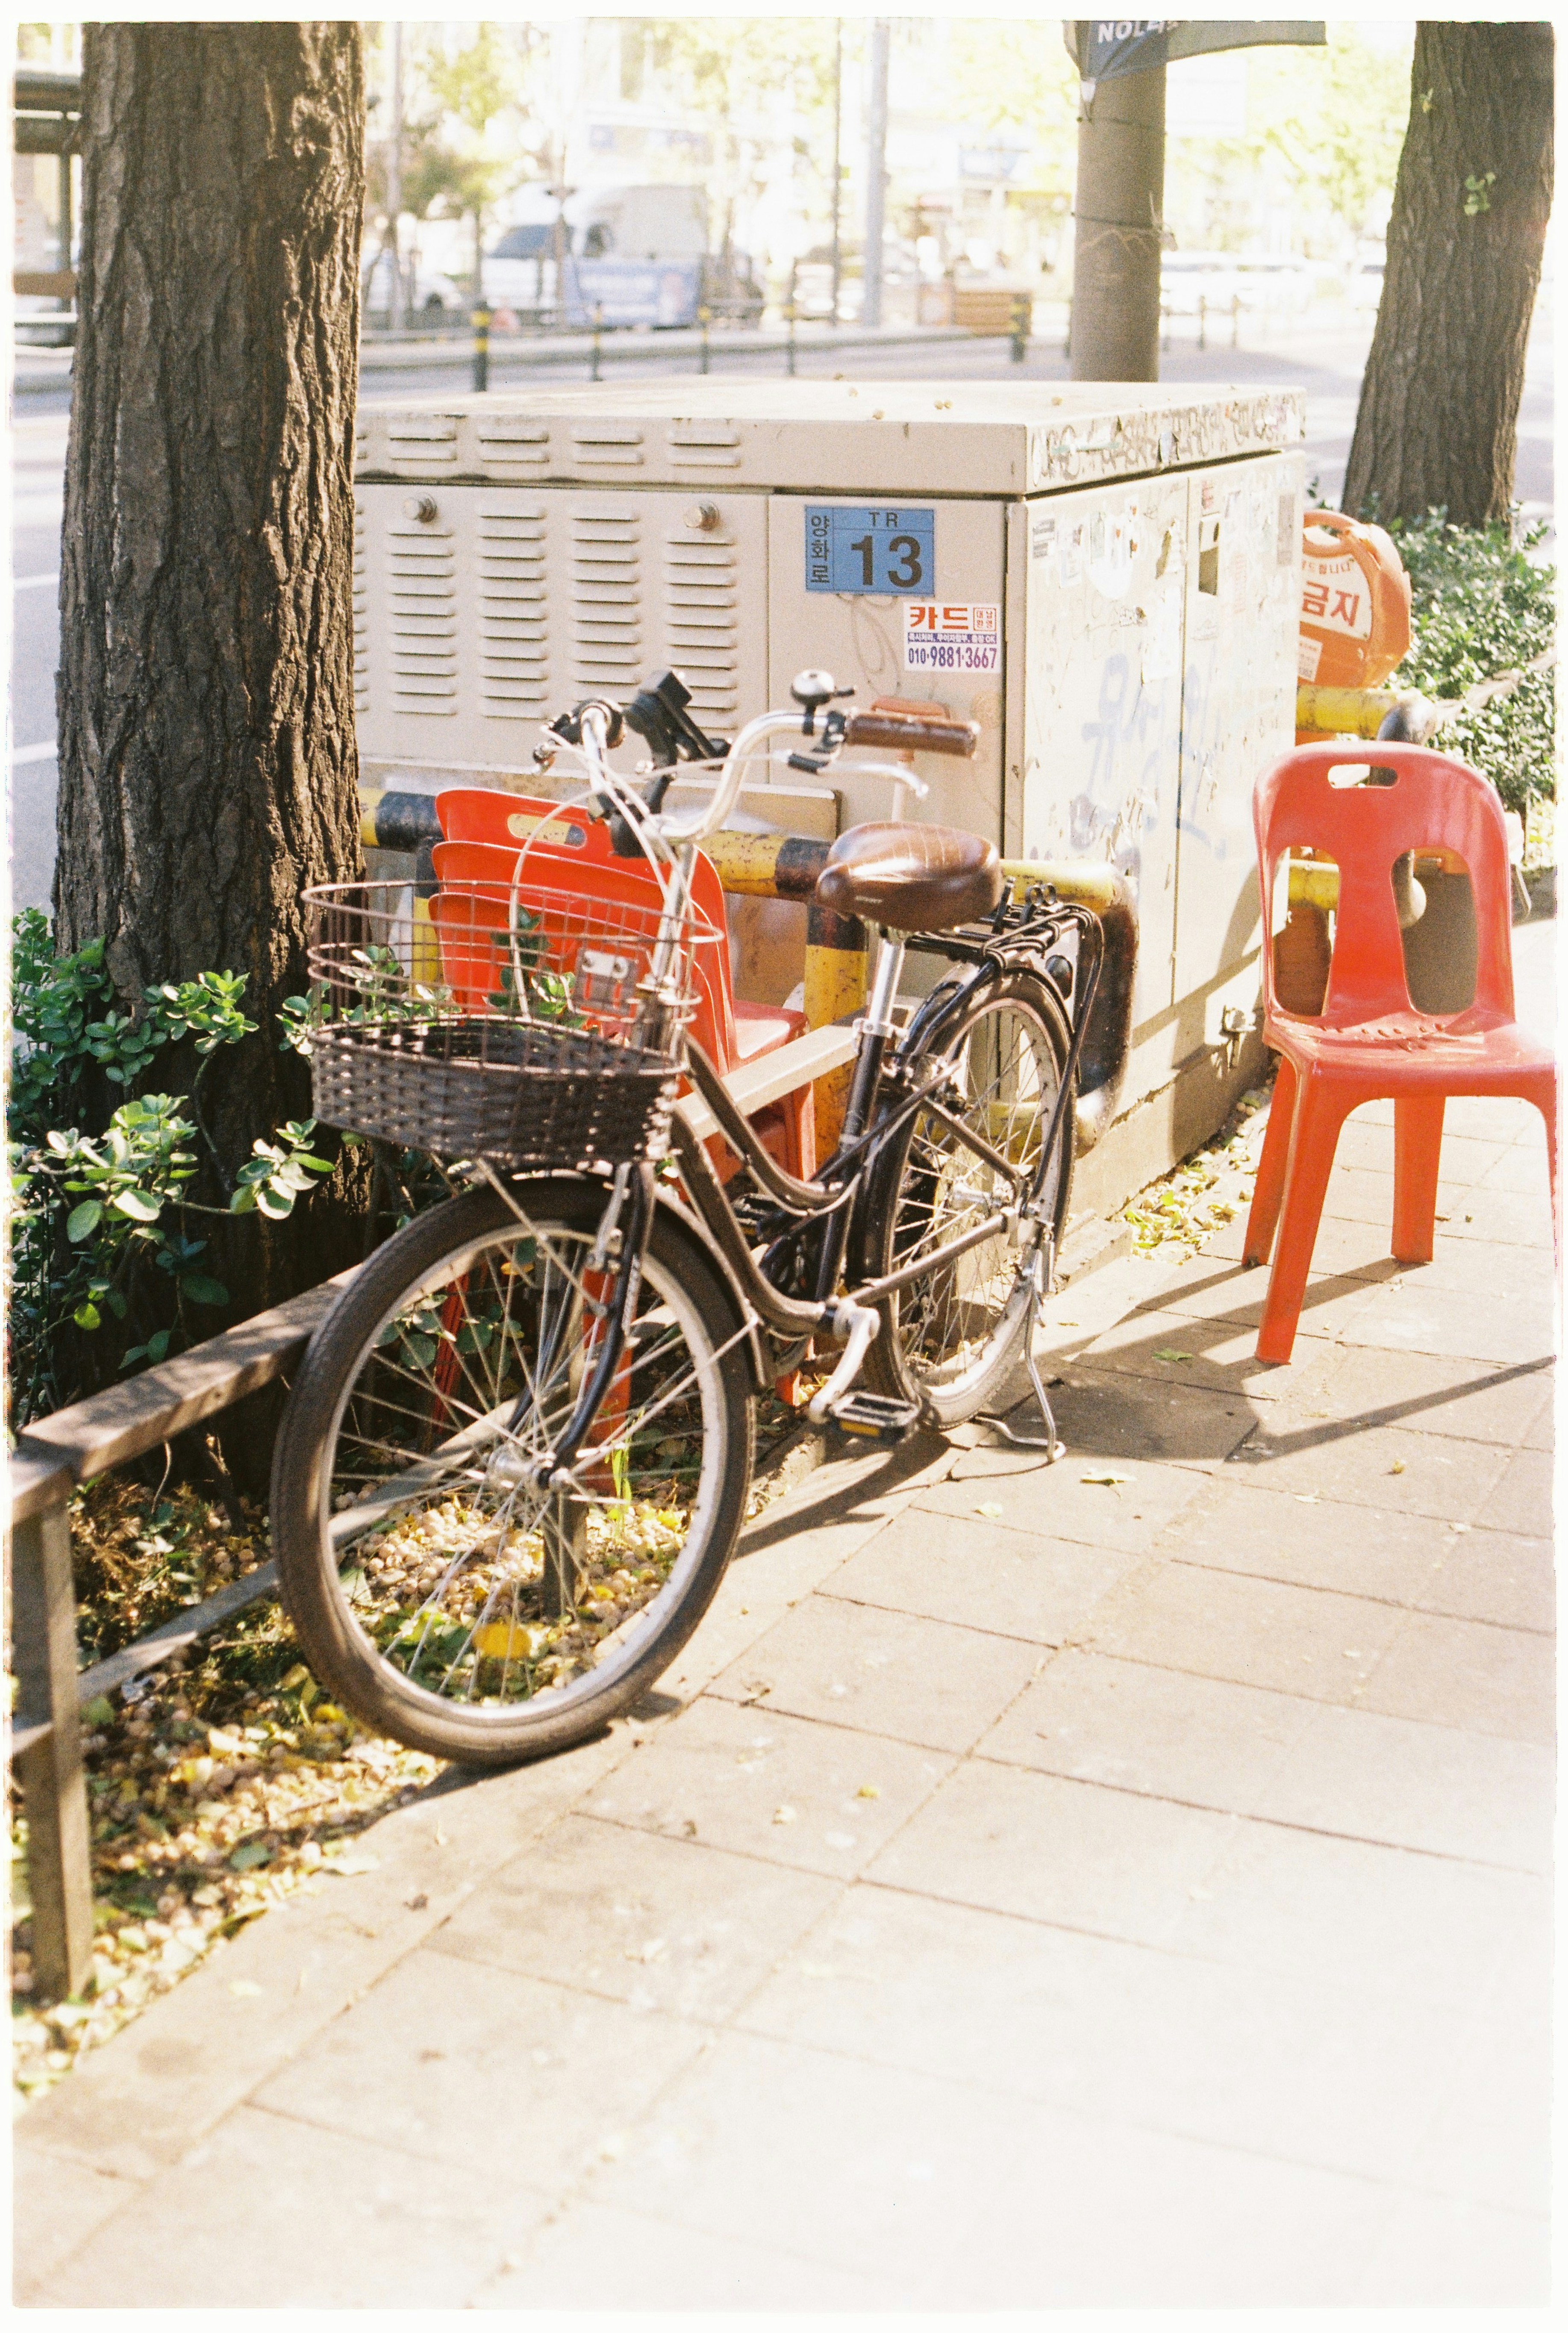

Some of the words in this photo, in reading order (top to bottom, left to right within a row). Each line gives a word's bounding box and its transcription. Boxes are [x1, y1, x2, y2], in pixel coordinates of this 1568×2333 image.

[869, 512, 897, 527] TR
[811, 515, 830, 583] 양화로
[851, 535, 922, 588] 13
[910, 606, 969, 630] 카드
